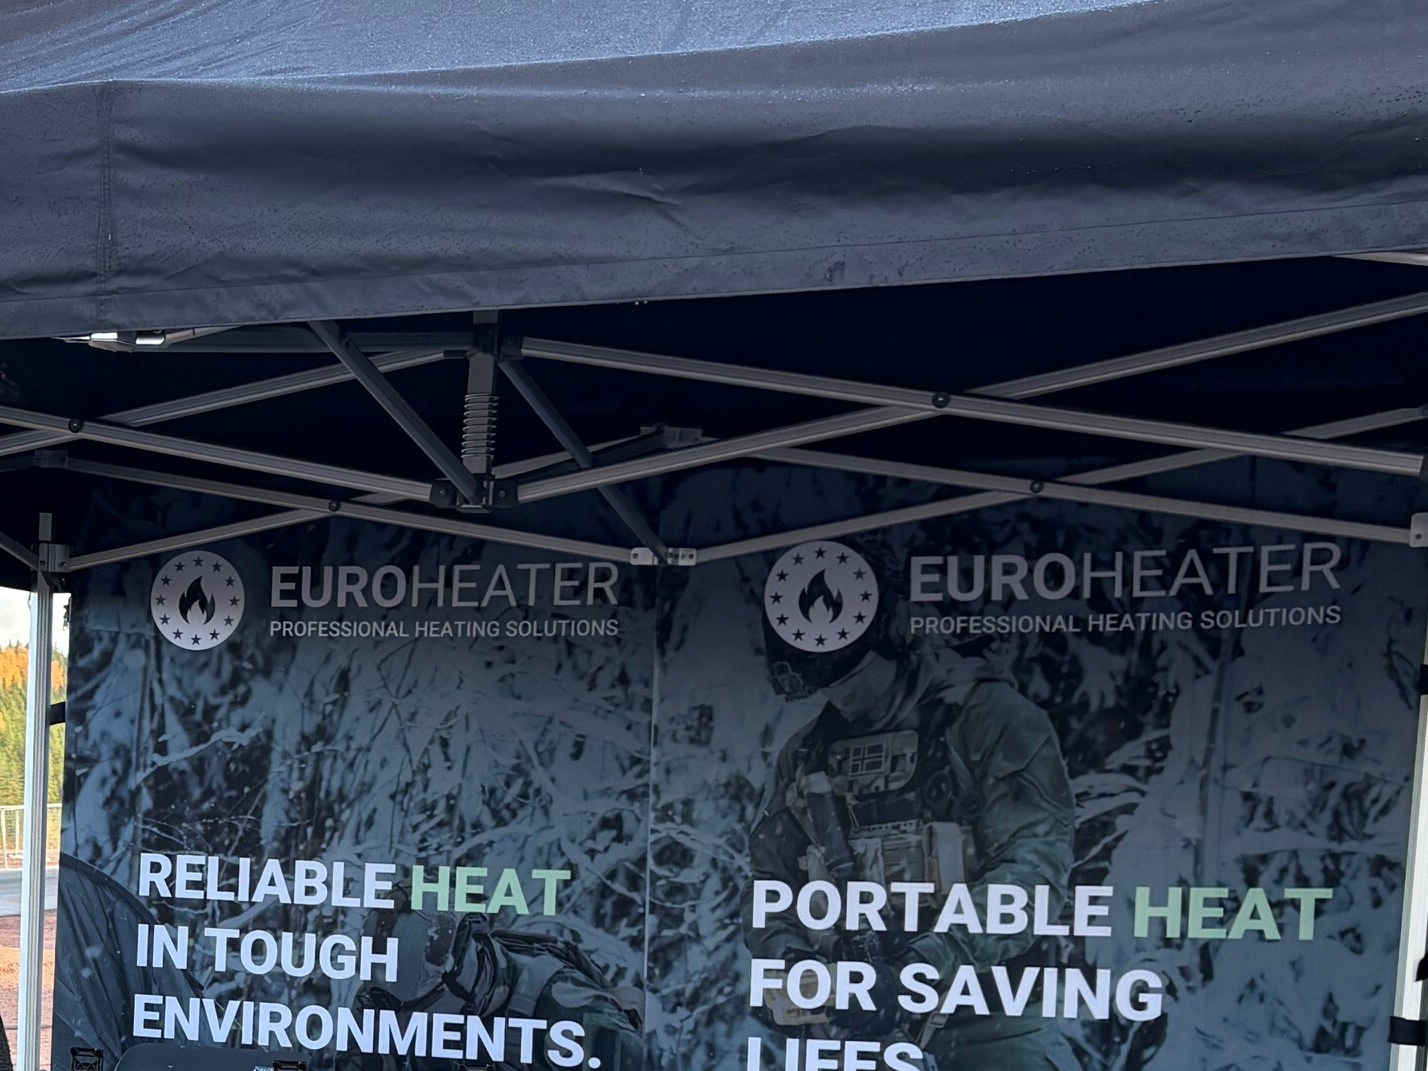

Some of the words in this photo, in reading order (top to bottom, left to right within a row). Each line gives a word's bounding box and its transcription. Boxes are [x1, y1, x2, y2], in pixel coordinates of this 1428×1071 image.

[270, 561, 619, 608] EUROHEATER
[909, 541, 1343, 602] EUROHEATER
[270, 620, 410, 637] PROFESSIONAL
[415, 619, 501, 637] HEATING
[505, 618, 619, 637] SOLUTIONS
[910, 614, 1081, 635] PROFESSIONAL
[1088, 611, 1194, 632] HEATING
[1199, 604, 1342, 630] SOLUTIONS
[138, 853, 396, 909] RELIABLE
[410, 864, 571, 916] HEAT
[752, 879, 1113, 937] PORTABLE
[1133, 886, 1334, 941] HEAT
[136, 923, 188, 970] IN
[204, 927, 400, 983] TOUGH
[748, 957, 877, 1011] FOR
[897, 962, 1163, 1022] SAVING
[132, 993, 602, 1069] ENVIRONMENTS.
